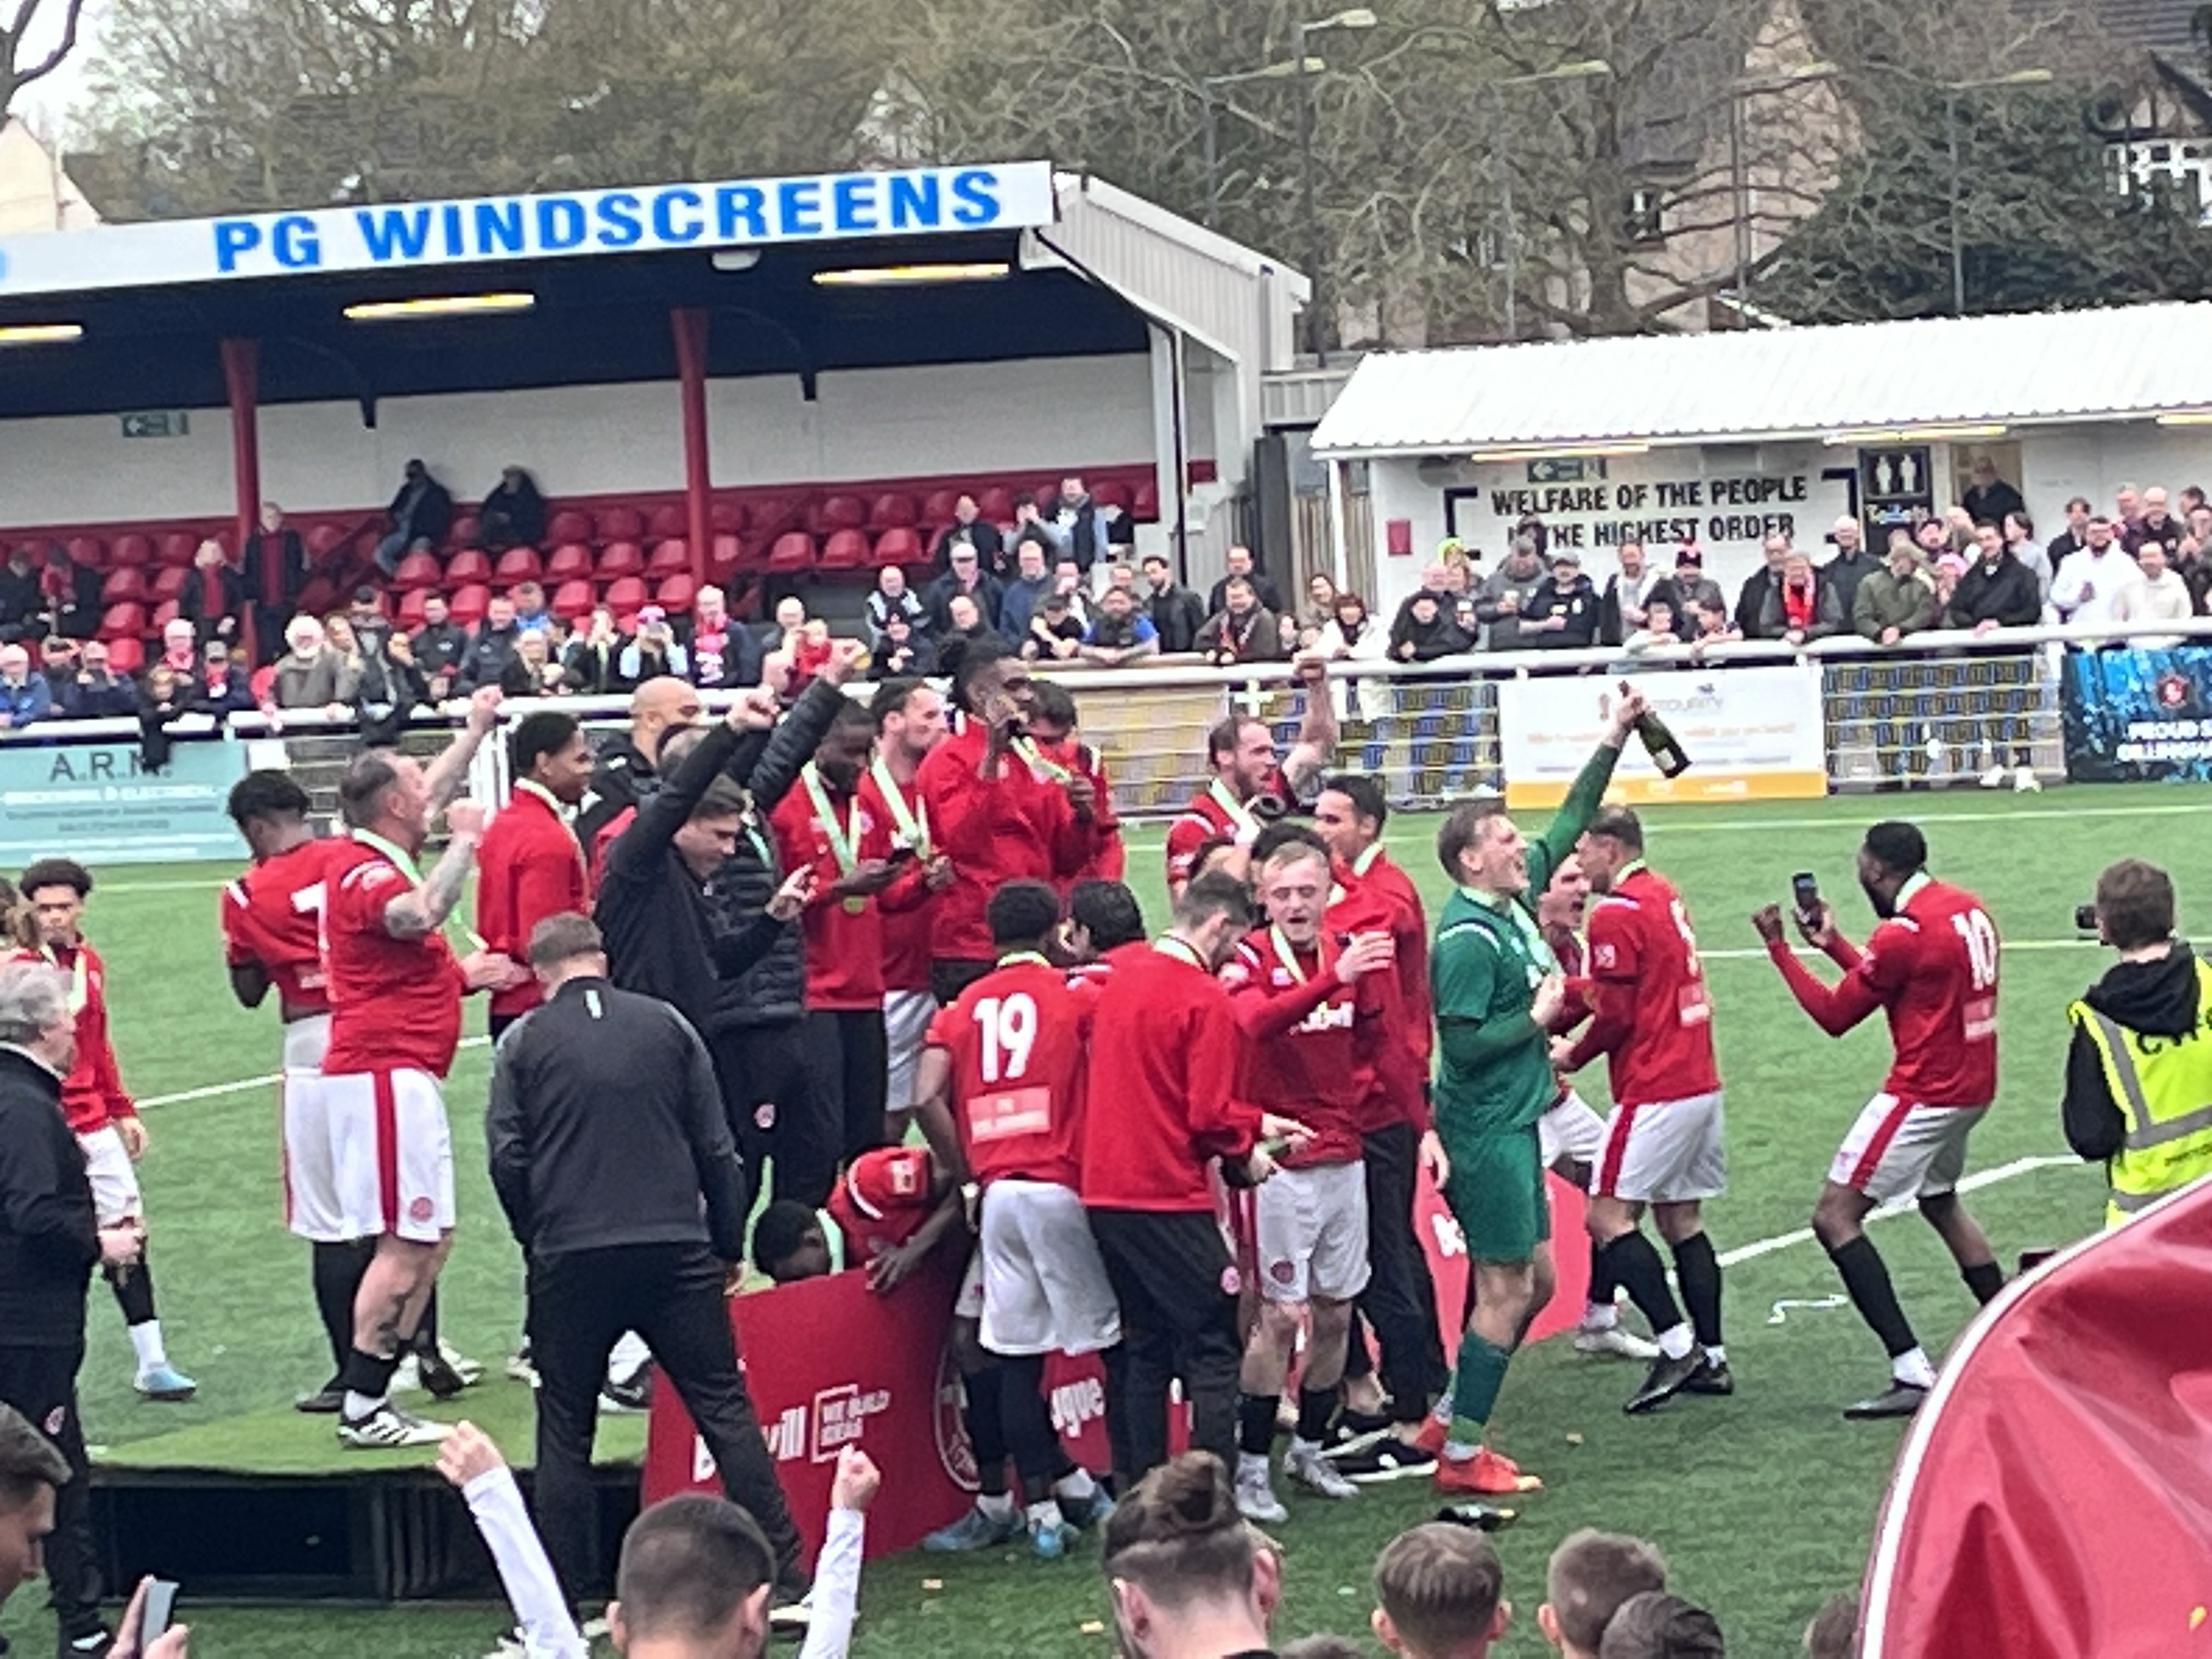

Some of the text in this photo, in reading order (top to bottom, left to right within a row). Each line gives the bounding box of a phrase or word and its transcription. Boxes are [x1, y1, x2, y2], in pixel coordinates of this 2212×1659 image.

[214, 171, 999, 272] PG WINDSCREENS
[1491, 476, 1807, 516] WELFARE OF THE PEOPLE
[1546, 523, 1584, 549] HE
[1594, 517, 1700, 546] HIGHEST
[1708, 513, 1794, 541] ORDER
[1949, 907, 1997, 990] 10
[972, 992, 1037, 1082] 19
